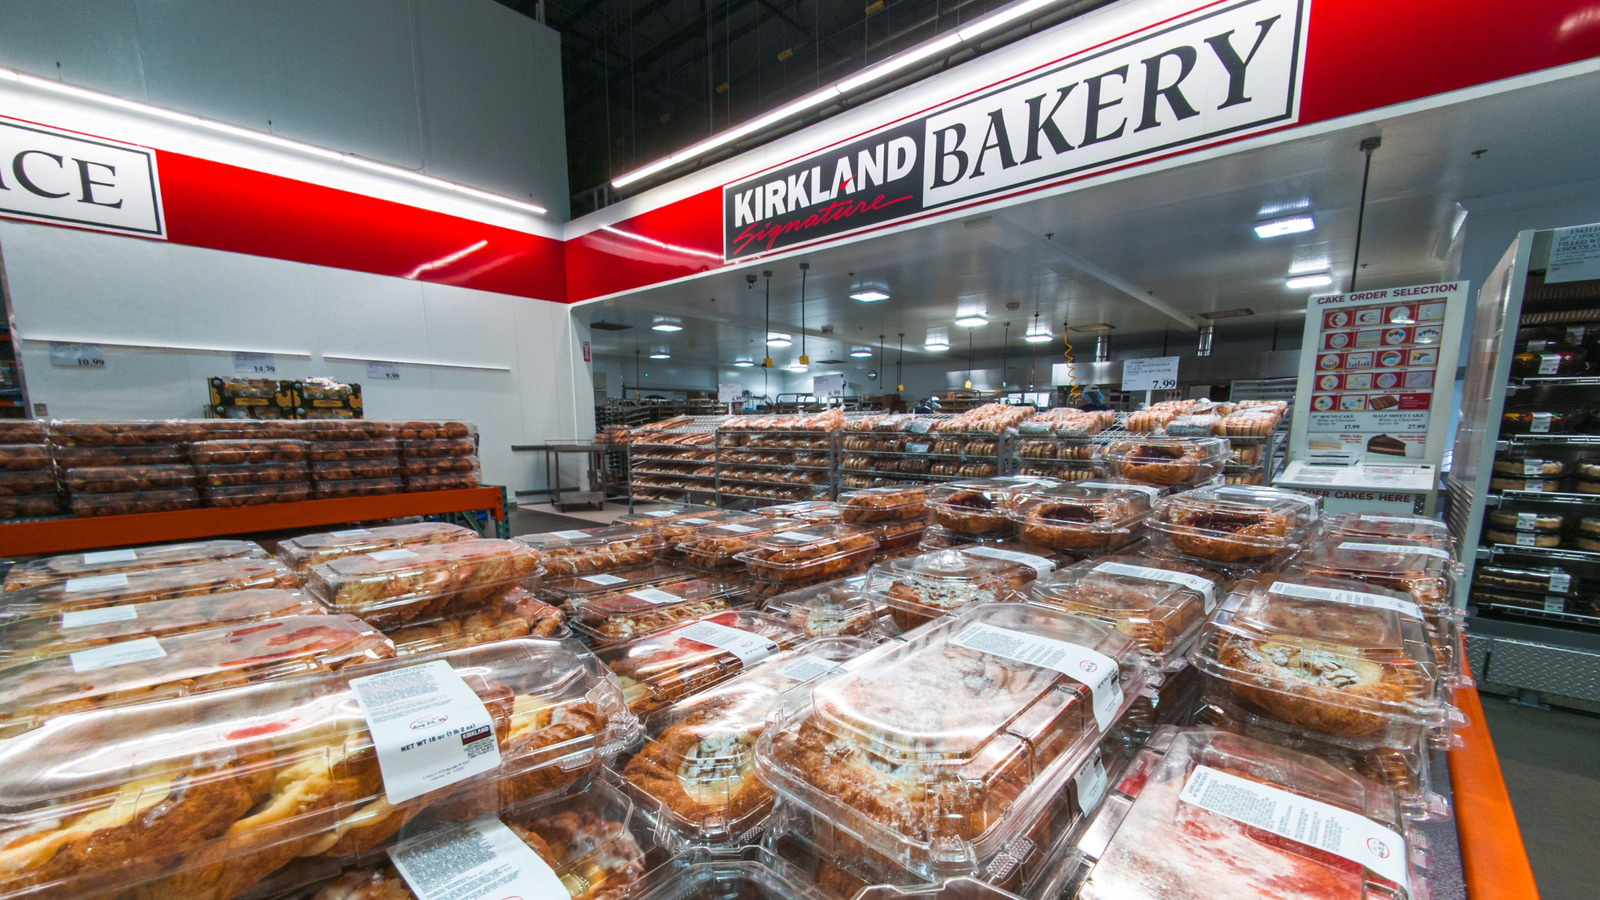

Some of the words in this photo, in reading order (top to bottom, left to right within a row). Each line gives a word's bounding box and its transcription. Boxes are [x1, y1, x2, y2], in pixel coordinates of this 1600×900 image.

[930, 15, 1281, 190] BAKERY
[733, 134, 918, 228] KIRKLAND
[732, 194, 913, 256] Signature
[1318, 295, 1345, 305] CAKE
[1350, 291, 1387, 301] ORDER
[1392, 284, 1458, 297] SELECTION
[78, 358, 104, 366] 10.99
[1153, 380, 1176, 389] 7.99
[1335, 491, 1373, 500] CAKES
[1378, 494, 1410, 502] HERE
[401, 744, 414, 752] NET
